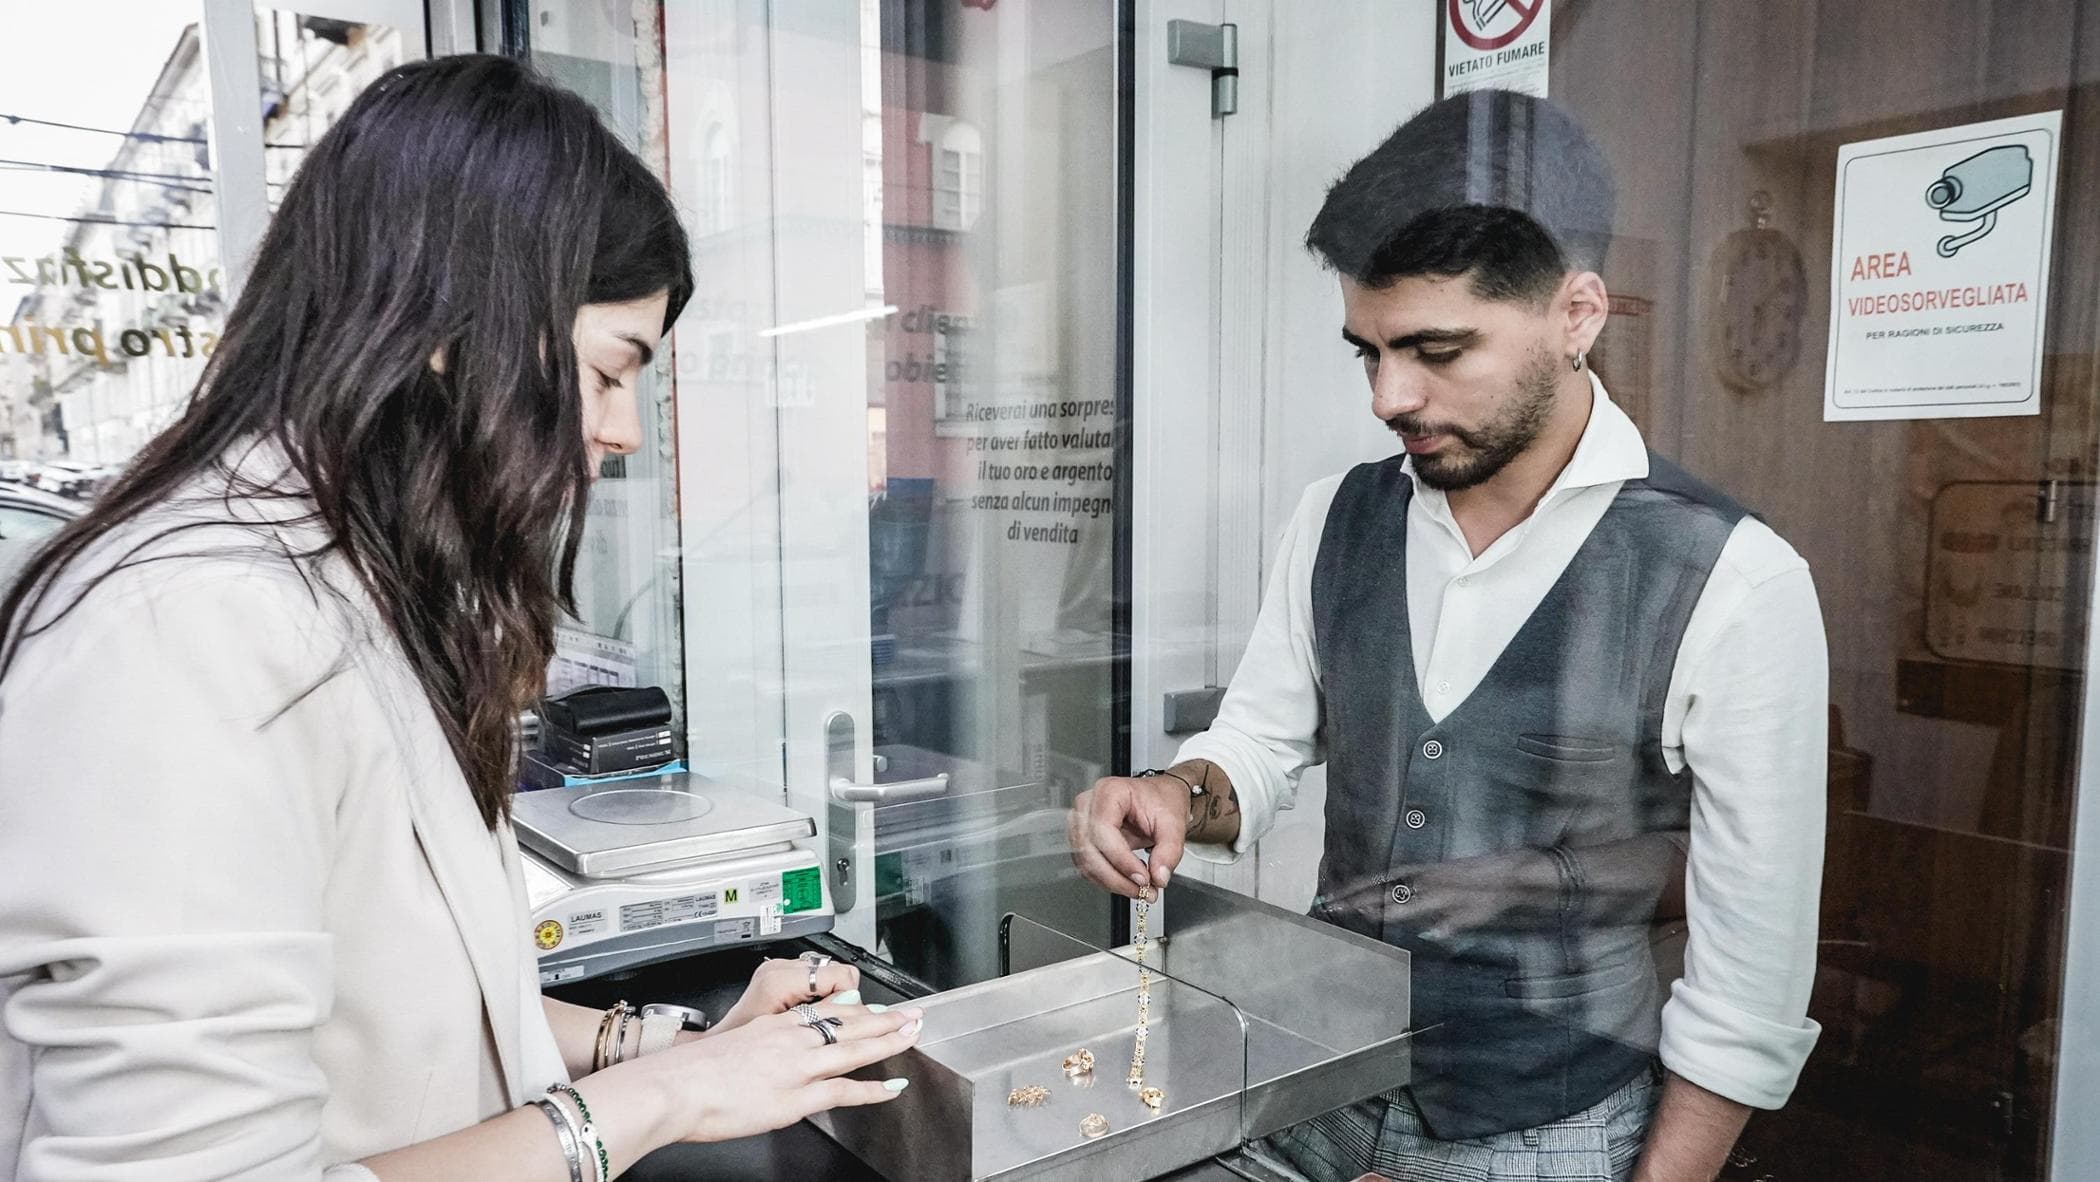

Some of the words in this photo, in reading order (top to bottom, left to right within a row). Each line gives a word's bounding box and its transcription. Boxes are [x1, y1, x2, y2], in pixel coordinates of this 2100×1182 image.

[1449, 56, 1492, 77] VIETATO
[1497, 41, 1545, 65] FUMARE
[1851, 251, 1912, 281] AREA
[1848, 283, 2028, 316] VIDEOSORVEGLIATA
[1866, 331, 1885, 340] PER
[1888, 328, 1930, 339] RAGIONI
[1933, 327, 1943, 335] DI
[1945, 322, 2004, 335] SICUREZZA
[966, 400, 1027, 422] Riceverai
[1030, 403, 1057, 419] una
[967, 437, 987, 456] per
[991, 437, 1020, 451] aver
[1023, 430, 1058, 450] fatto
[1062, 428, 1114, 450] valuta
[978, 461, 986, 480] il
[989, 463, 1011, 480] tuo
[1014, 465, 1037, 480] oro
[1041, 466, 1049, 480] e
[1053, 463, 1113, 487] argento
[972, 495, 1008, 511] senza
[1012, 491, 1049, 512] alcun
[1053, 492, 1113, 518] impegn
[1008, 520, 1021, 541] di
[1024, 522, 1078, 544] vendita
[725, 889, 737, 903] M
[571, 912, 602, 923] LAUMAS
